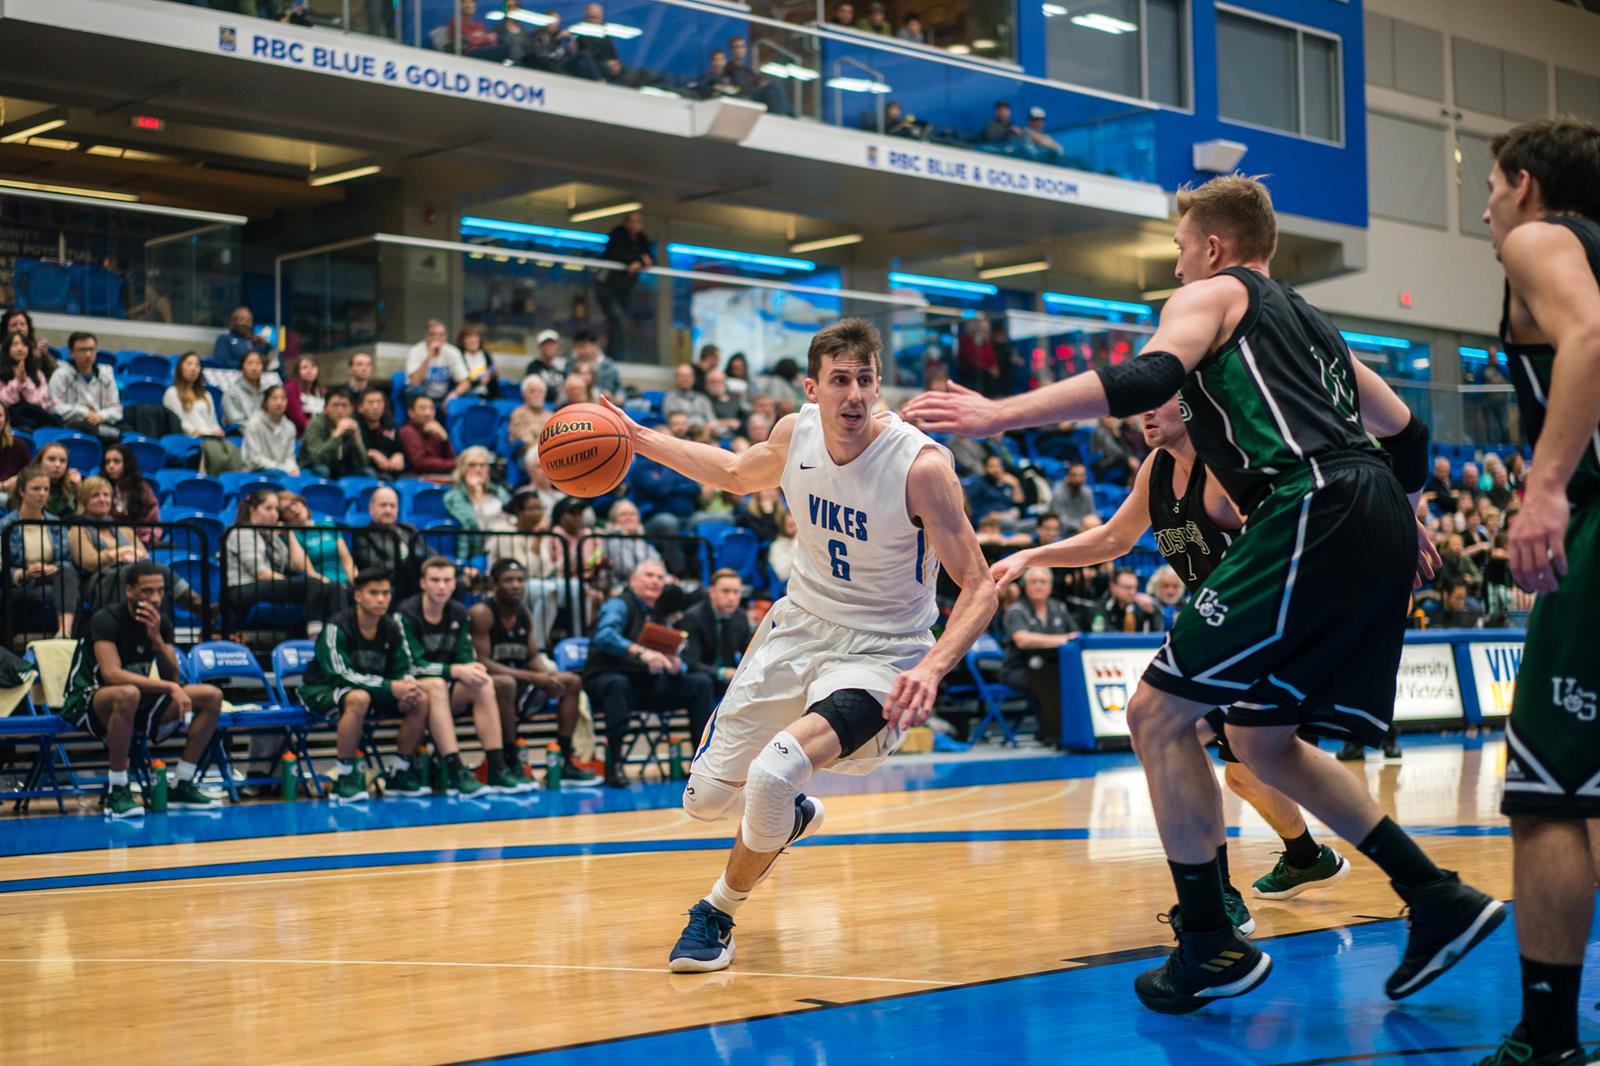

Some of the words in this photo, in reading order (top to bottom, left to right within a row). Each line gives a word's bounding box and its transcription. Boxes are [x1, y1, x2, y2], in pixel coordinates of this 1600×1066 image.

[253, 34, 304, 63] RBC
[313, 47, 376, 77] BLUE
[383, 60, 398, 81] &
[406, 65, 471, 93] GOLD
[478, 77, 545, 106] ROOM
[888, 151, 921, 172] RBC
[927, 158, 968, 181] BLUE
[987, 169, 1029, 190] GOLD
[1034, 177, 1079, 197] ROOM
[540, 420, 593, 446] Wilson
[808, 493, 868, 542] VIKES
[828, 538, 852, 582] 6
